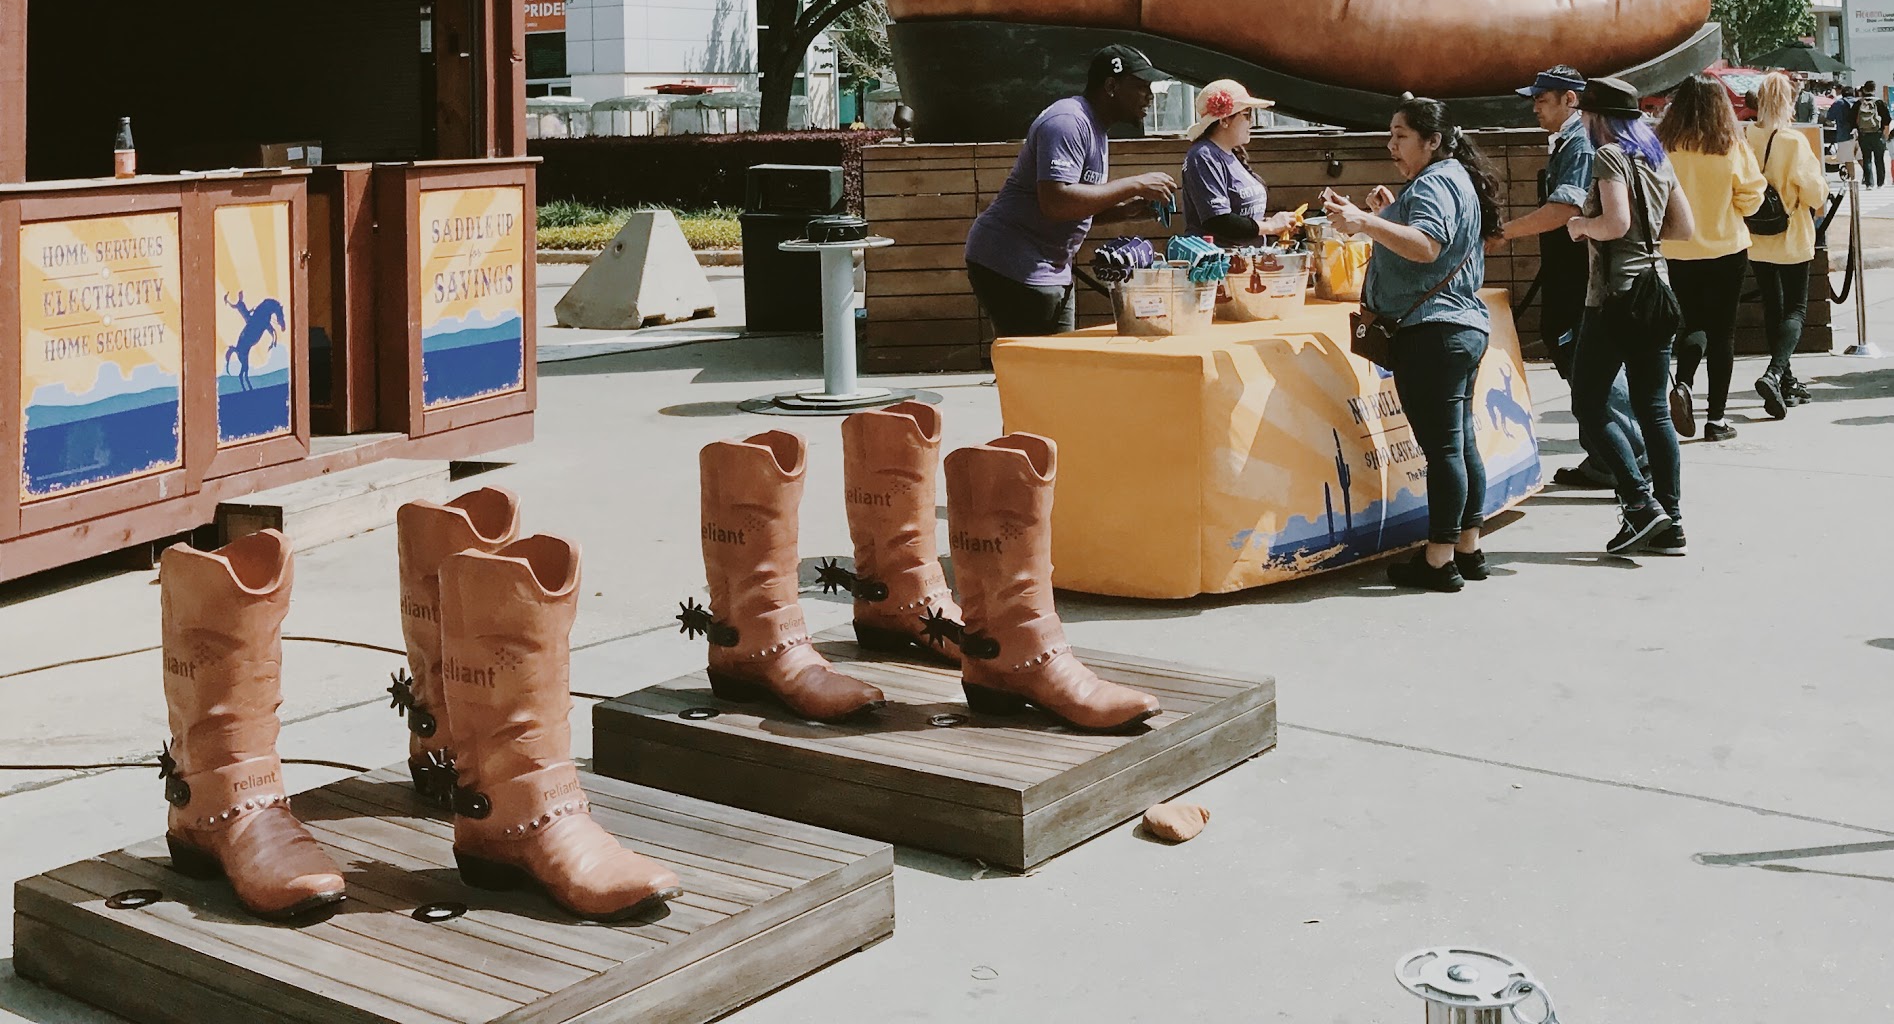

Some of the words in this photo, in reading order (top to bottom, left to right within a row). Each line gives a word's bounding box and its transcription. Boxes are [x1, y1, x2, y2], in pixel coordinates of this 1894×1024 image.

[1111, 57, 1124, 74] 3
[431, 216, 494, 244] SADDLE
[497, 213, 514, 237] UP
[42, 243, 89, 268] HOME
[95, 235, 164, 264] SERVICES
[43, 277, 165, 318] ELECTRICITY
[434, 264, 514, 304] SAVINGS
[44, 334, 91, 362] HOME
[96, 323, 167, 355] SECURITY
[1347, 396, 1371, 425] NO
[846, 487, 892, 507] eliant
[701, 521, 746, 545] eliant
[951, 531, 1003, 555] eliant
[442, 656, 497, 689] eliant
[233, 770, 279, 793] reliant
